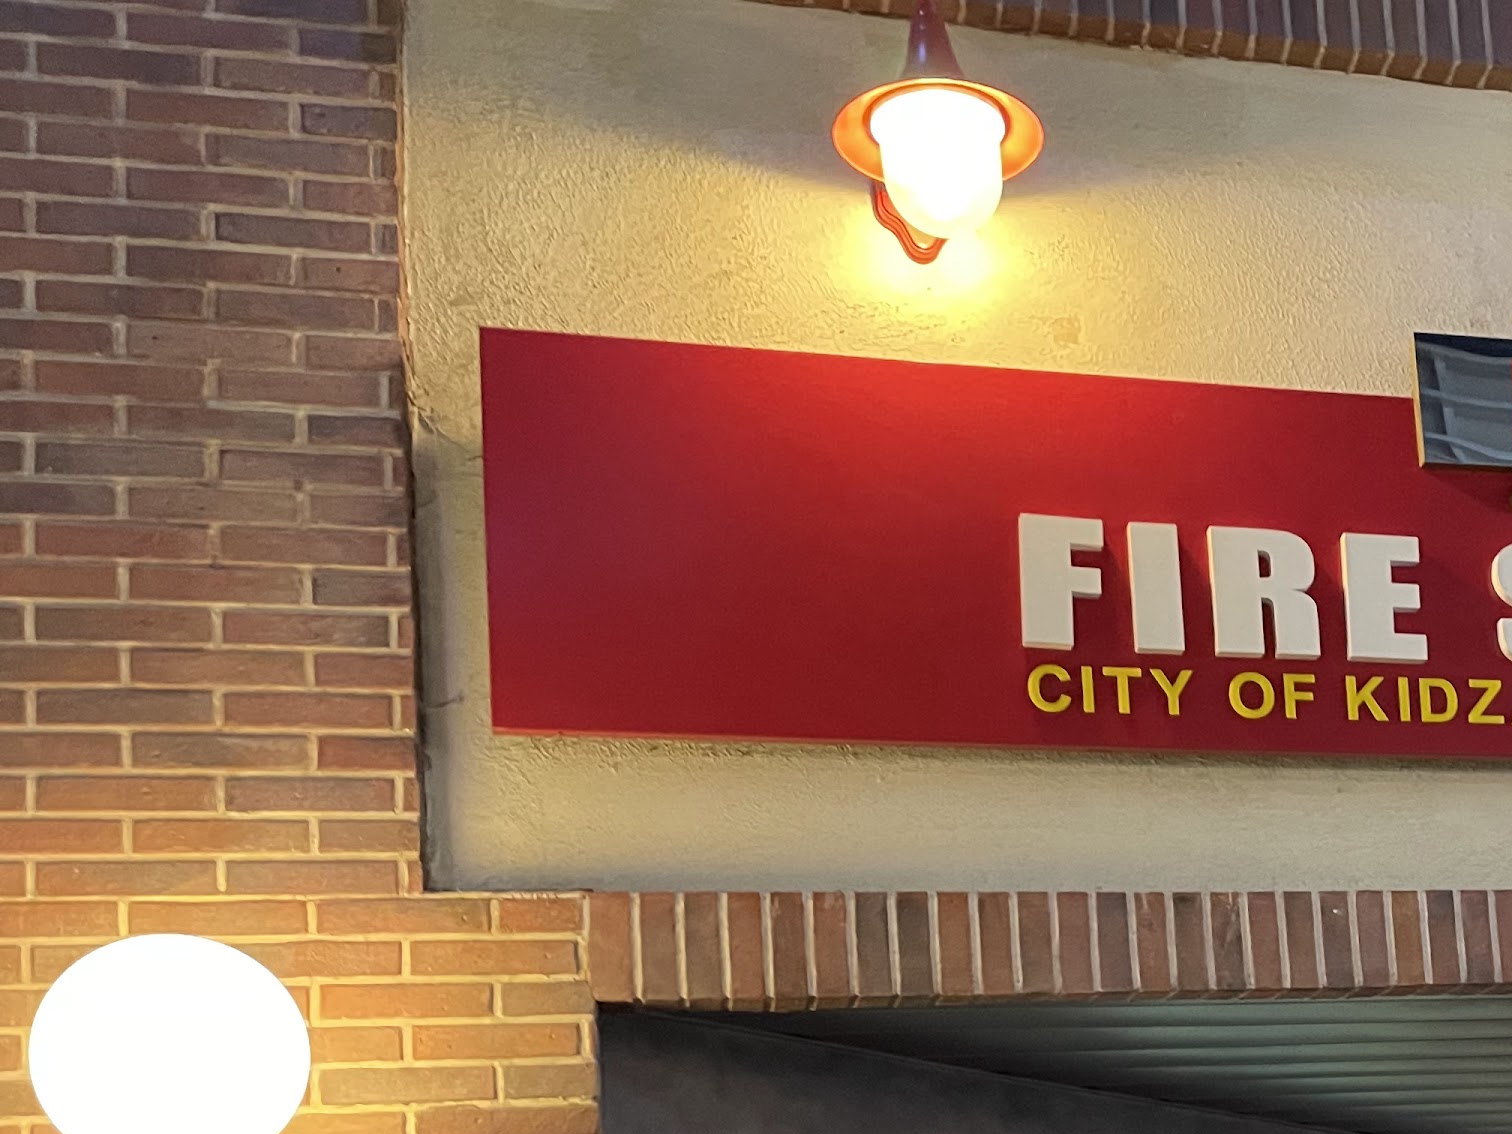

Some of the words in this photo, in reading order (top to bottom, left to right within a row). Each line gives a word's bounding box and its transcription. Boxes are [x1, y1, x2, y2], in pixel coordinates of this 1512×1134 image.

[1017, 512, 1429, 662] FIRE
[1026, 663, 1193, 717] CITY
[1227, 671, 1317, 721] OF
